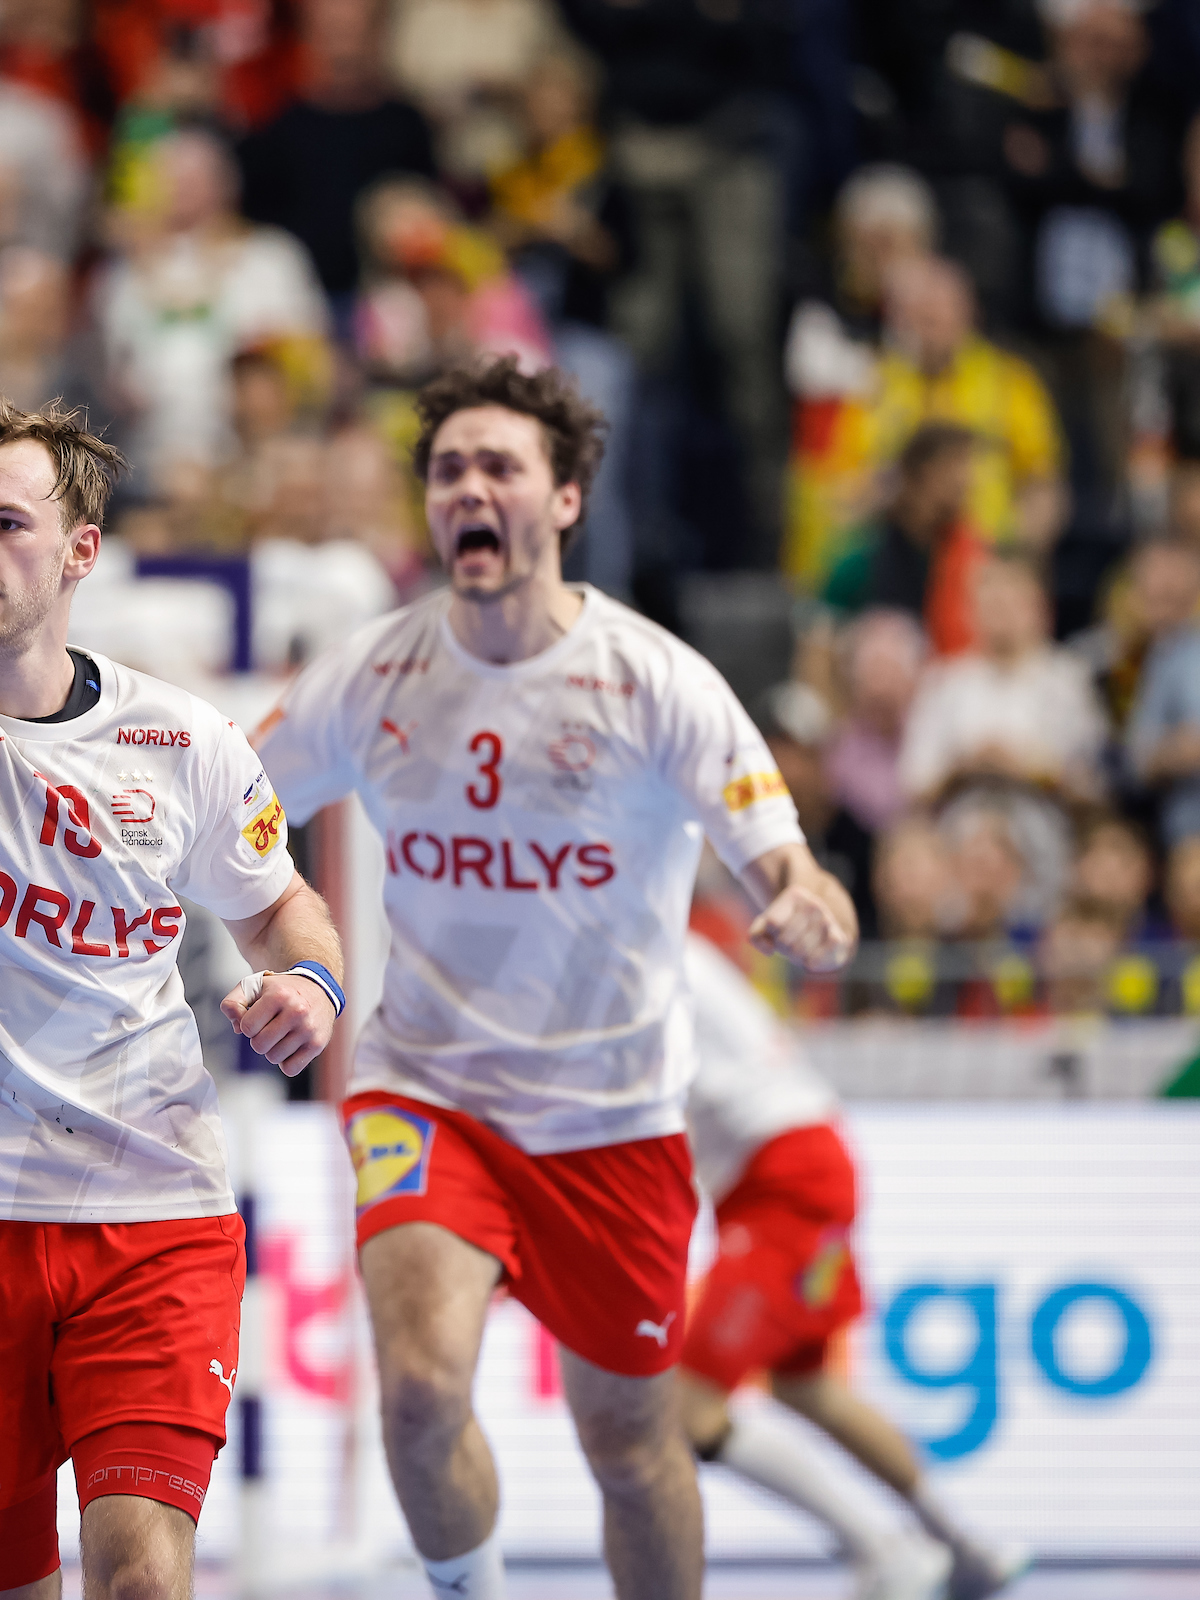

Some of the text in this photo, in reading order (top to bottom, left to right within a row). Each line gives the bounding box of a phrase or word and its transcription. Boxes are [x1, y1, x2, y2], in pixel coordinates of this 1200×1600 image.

[116, 727, 192, 748] NORLYS
[465, 731, 503, 809] 3
[33, 770, 103, 859] 19
[121, 829, 158, 838] Dansk
[86, 1465, 207, 1508] compress
